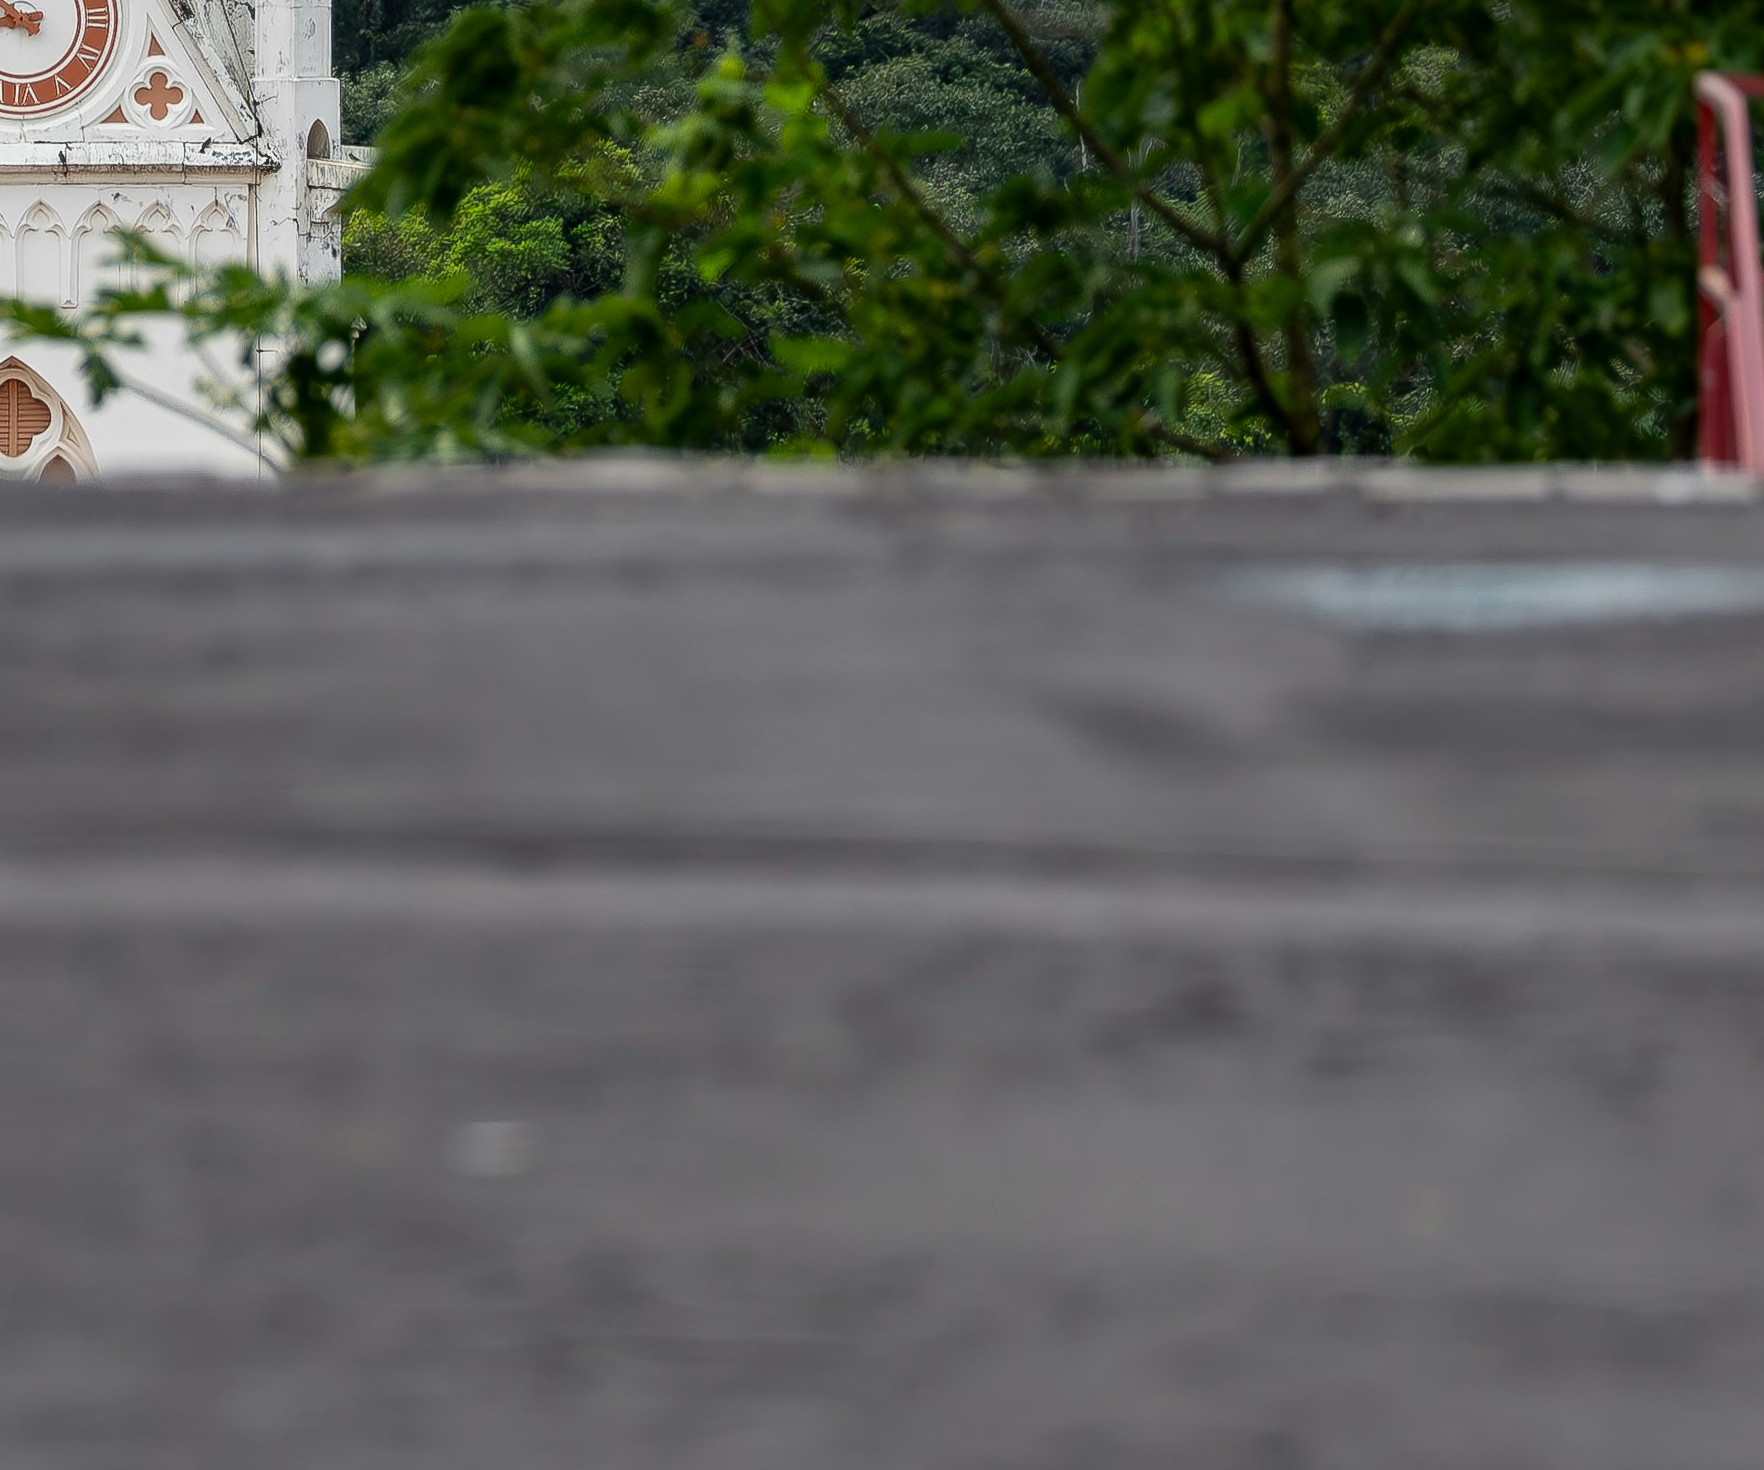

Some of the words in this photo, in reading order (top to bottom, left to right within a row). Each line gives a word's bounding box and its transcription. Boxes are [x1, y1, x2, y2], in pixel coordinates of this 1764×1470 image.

[86, 7, 108, 29] III
[76, 44, 101, 72] IV
[13, 82, 40, 105] VI
[53, 75, 72, 96] V
